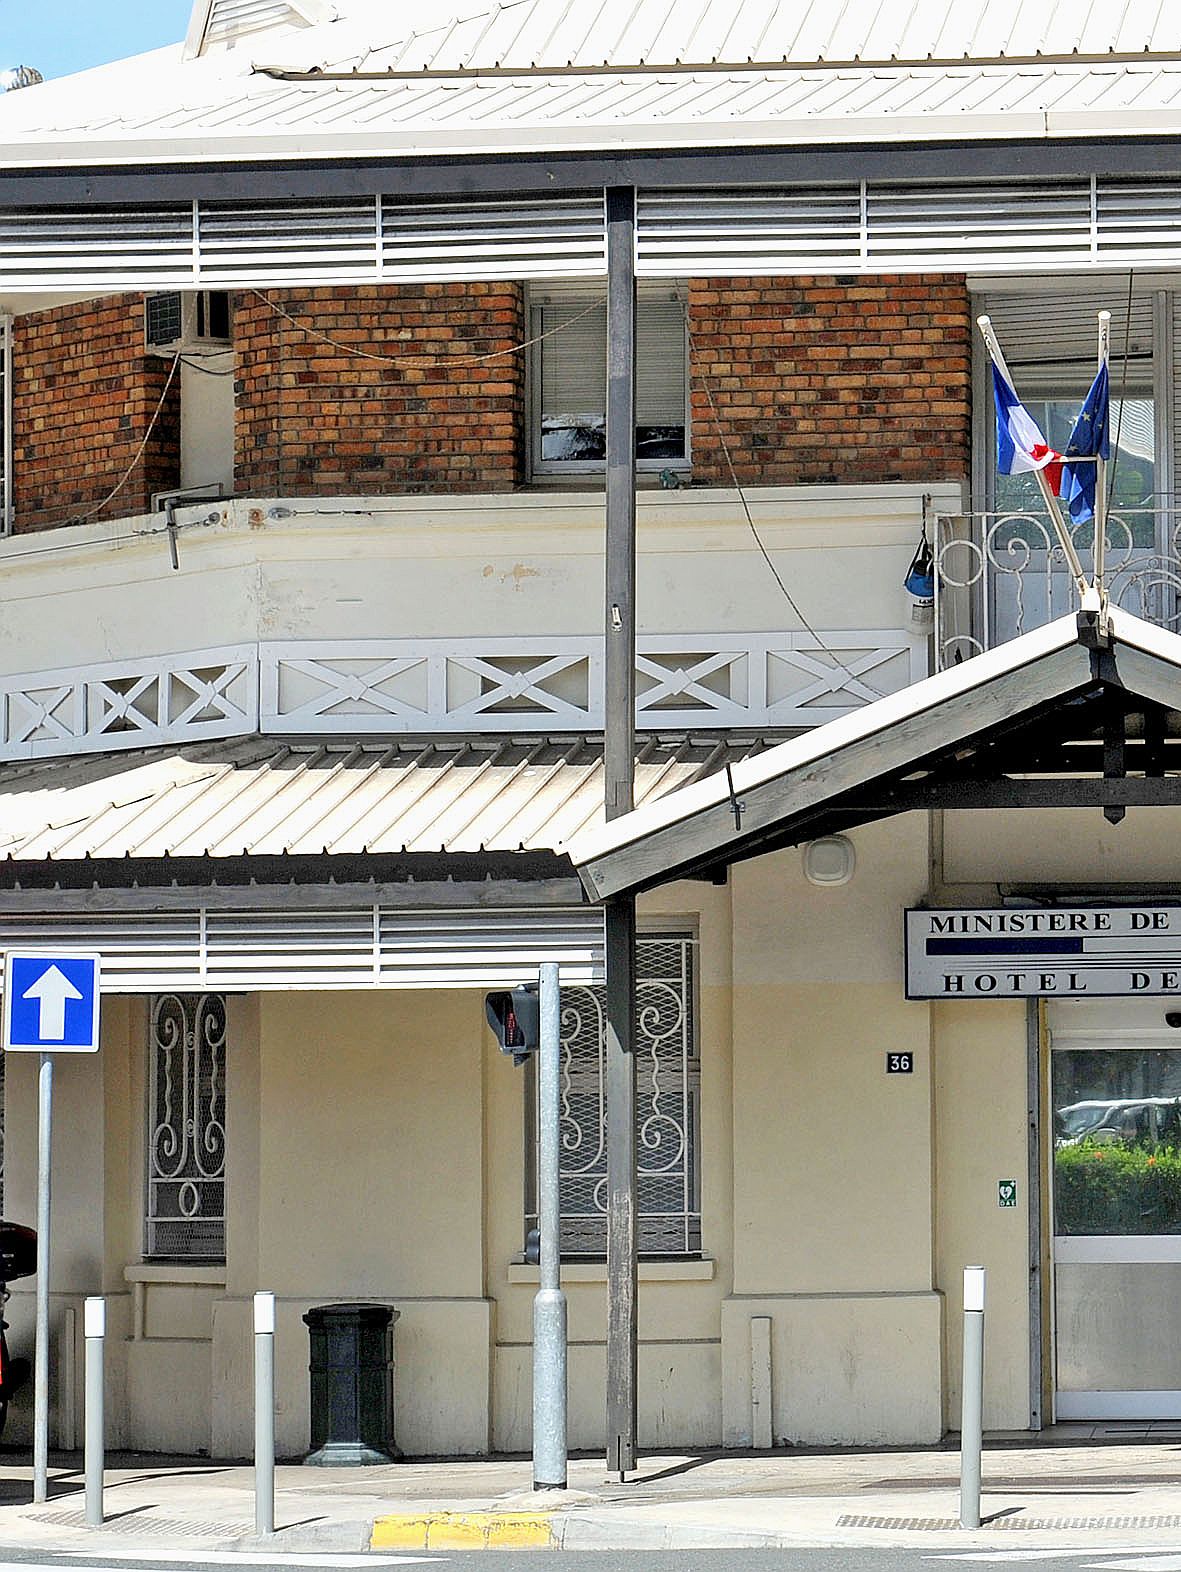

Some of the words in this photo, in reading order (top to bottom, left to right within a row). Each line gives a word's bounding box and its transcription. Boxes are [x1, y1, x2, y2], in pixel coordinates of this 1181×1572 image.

[930, 912, 1112, 934] MINISTERE
[1130, 911, 1170, 931] DE
[942, 972, 1088, 993] HOTEL
[1129, 971, 1179, 990] DE
[890, 1055, 910, 1071] 36
